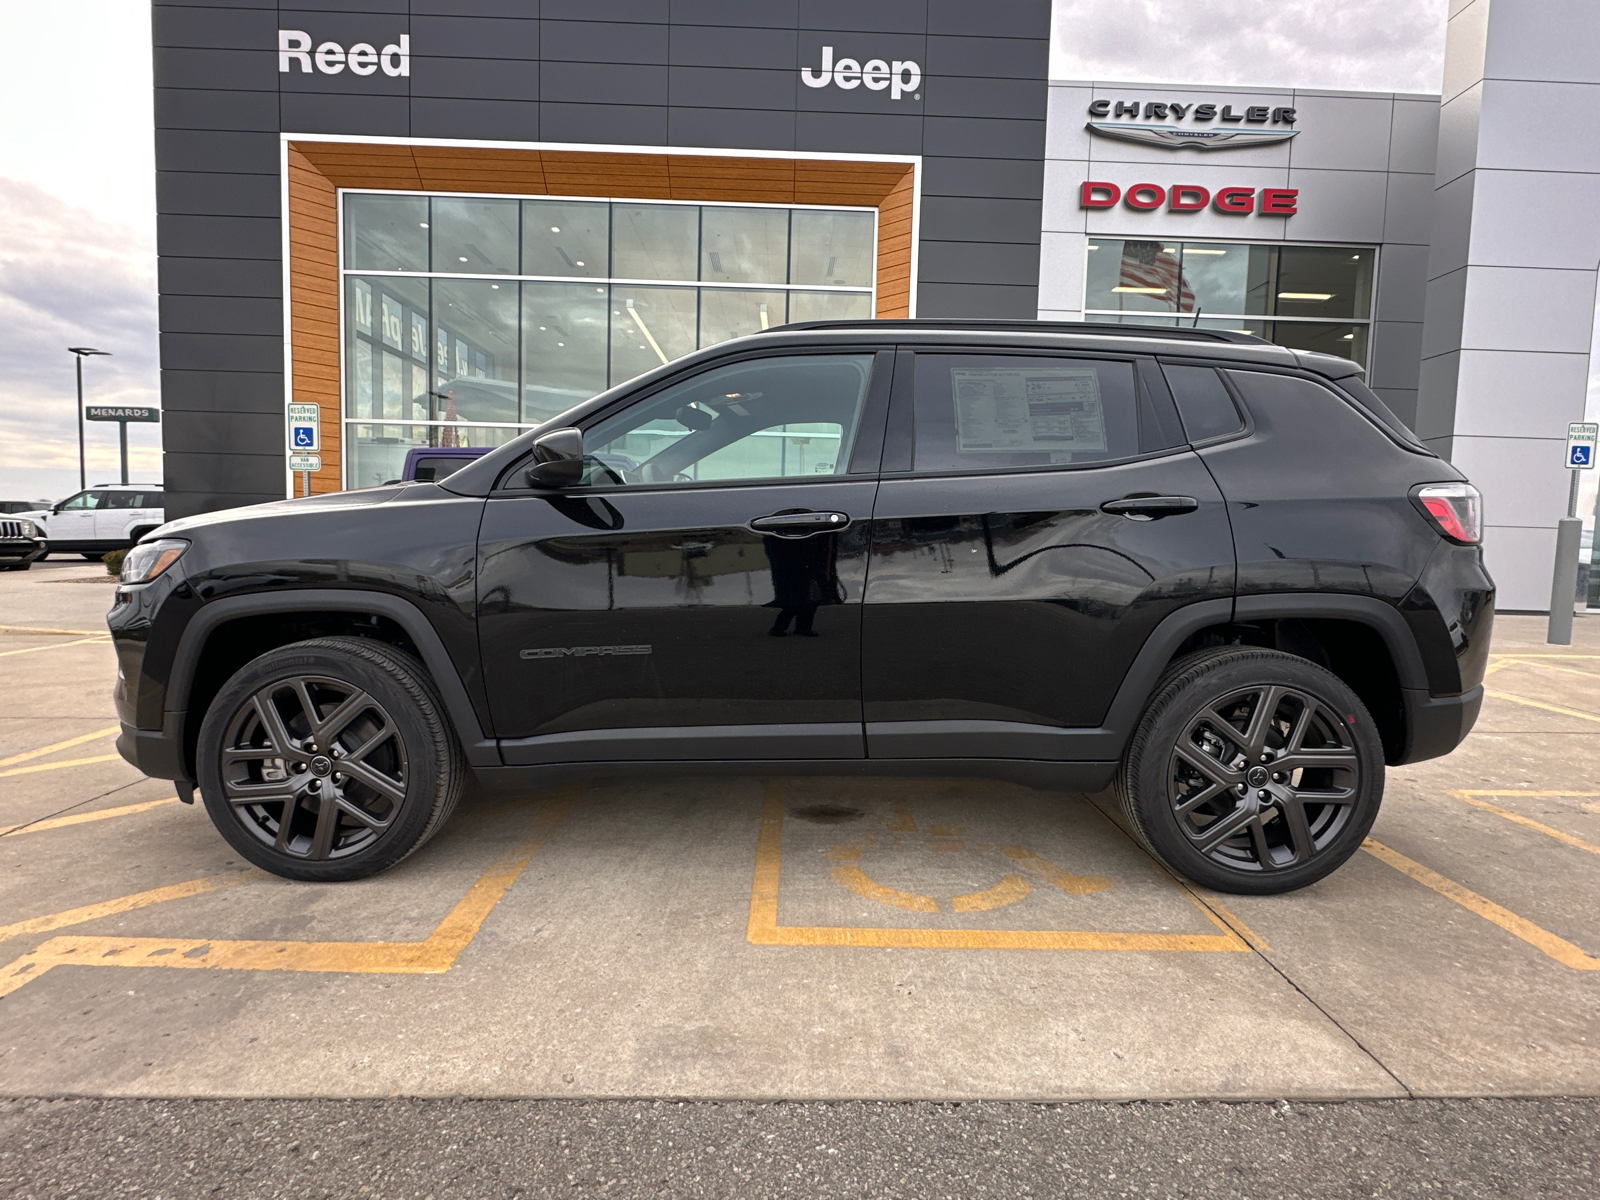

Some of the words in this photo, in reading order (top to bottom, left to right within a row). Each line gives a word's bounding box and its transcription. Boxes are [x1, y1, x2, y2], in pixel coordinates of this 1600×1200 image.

[278, 29, 410, 77] Reed
[1089, 99, 1297, 123] CHRYSLER
[1079, 181, 1299, 216] DODGE
[90, 408, 149, 417] MENARDS
[290, 407, 317, 415] RESERVED
[290, 415, 317, 423] PARKING
[520, 645, 652, 659] COMPASS
